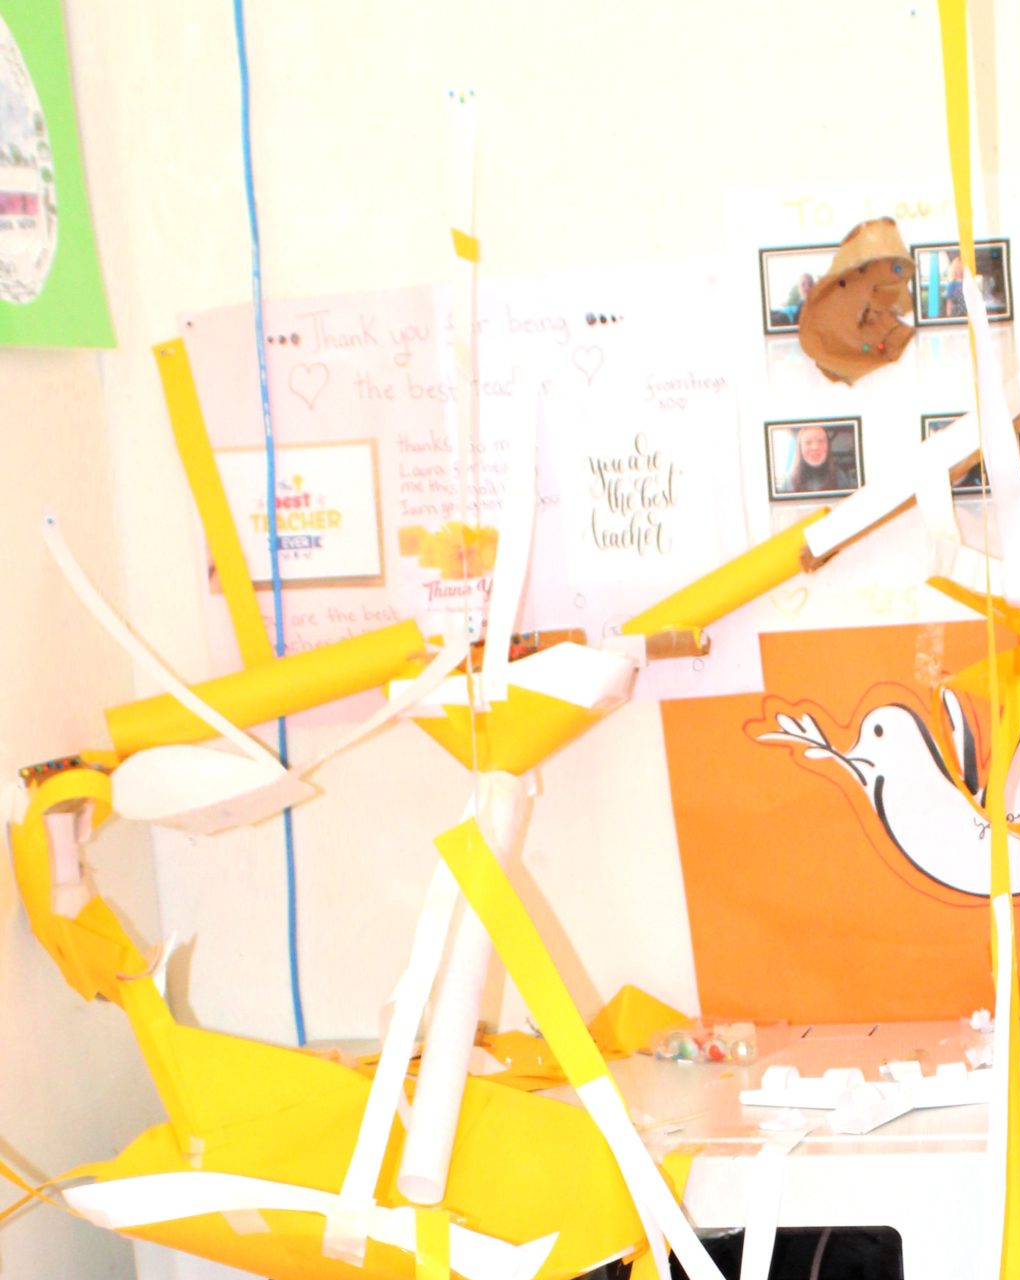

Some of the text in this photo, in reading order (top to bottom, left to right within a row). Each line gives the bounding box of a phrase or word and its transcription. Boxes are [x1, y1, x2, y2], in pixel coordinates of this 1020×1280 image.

[389, 325, 430, 368] you
[352, 371, 396, 401] the
[406, 371, 458, 404] best
